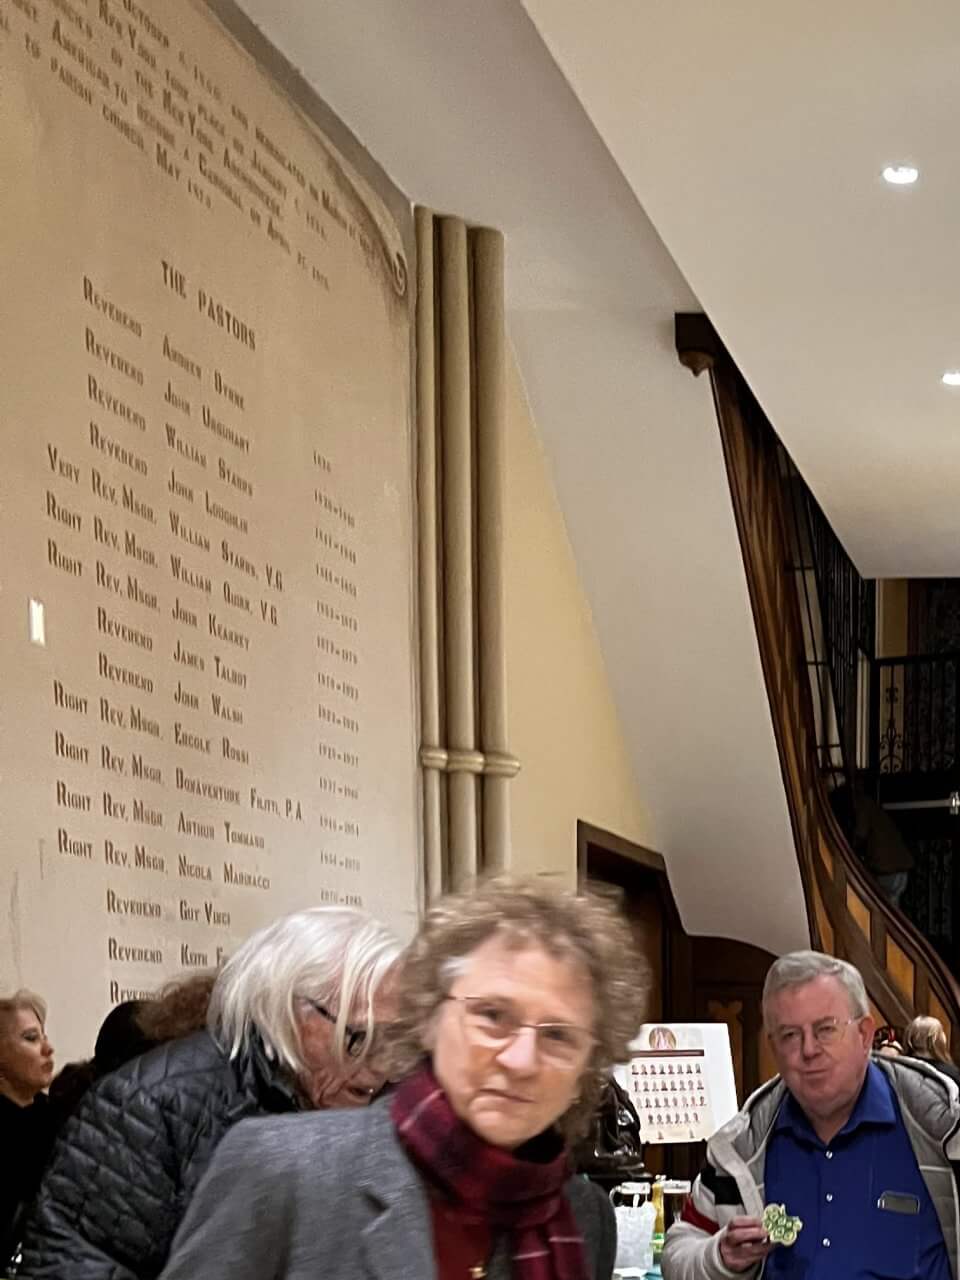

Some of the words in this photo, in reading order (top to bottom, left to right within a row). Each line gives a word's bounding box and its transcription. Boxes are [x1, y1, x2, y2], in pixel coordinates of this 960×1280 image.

[128, 27, 156, 69] YORK
[102, 105, 145, 152] CHURCH
[156, 143, 181, 182] MAY
[163, 89, 184, 126] NEW
[188, 115, 213, 153] YORK
[83, 275, 142, 337] REVEREND
[161, 260, 187, 299] THE
[199, 290, 256, 351] PASTORS
[85, 327, 144, 386] REVEREND
[164, 381, 191, 416] JOHN
[88, 374, 146, 432] REVEREND
[165, 423, 207, 468] WILLIAM
[48, 443, 80, 484] VERY
[91, 468, 118, 506] REV.
[169, 510, 210, 552] WILLIAM
[90, 421, 148, 476] REVEREND
[167, 470, 194, 503] JOHN
[46, 490, 82, 532] RIGHT
[93, 516, 123, 551] REV.
[170, 554, 211, 595] WILLIAM
[48, 538, 83, 577] RIGHT
[95, 560, 124, 595] REV.
[172, 599, 198, 629] JOHN
[97, 607, 153, 652] REVEREND
[173, 640, 204, 673] JAMES
[214, 655, 248, 690] TALBOT
[53, 680, 88, 716] RIGHT
[100, 698, 126, 730] REV.
[174, 723, 211, 756] ERCOLE
[222, 737, 249, 766] ROSSI
[99, 652, 154, 694] REVEREND
[174, 681, 199, 710] JOHN
[211, 693, 243, 726] WALSH
[55, 730, 89, 766] RIGHT
[101, 745, 127, 776] REV.
[175, 768, 241, 806] BONAVENTURE
[56, 780, 91, 813] RIGHT
[103, 792, 128, 823] REV.
[177, 812, 215, 842] ARTHUR
[224, 822, 265, 849] TOMMASO
[58, 828, 92, 860] RIGHT
[104, 840, 130, 869] REV.
[178, 856, 212, 882] NICOLA
[106, 889, 161, 918] REVEREND
[179, 900, 200, 923] GUY
[204, 903, 231, 928] VINCI
[108, 937, 163, 965] REVEREND
[180, 944, 208, 967] KEITH
